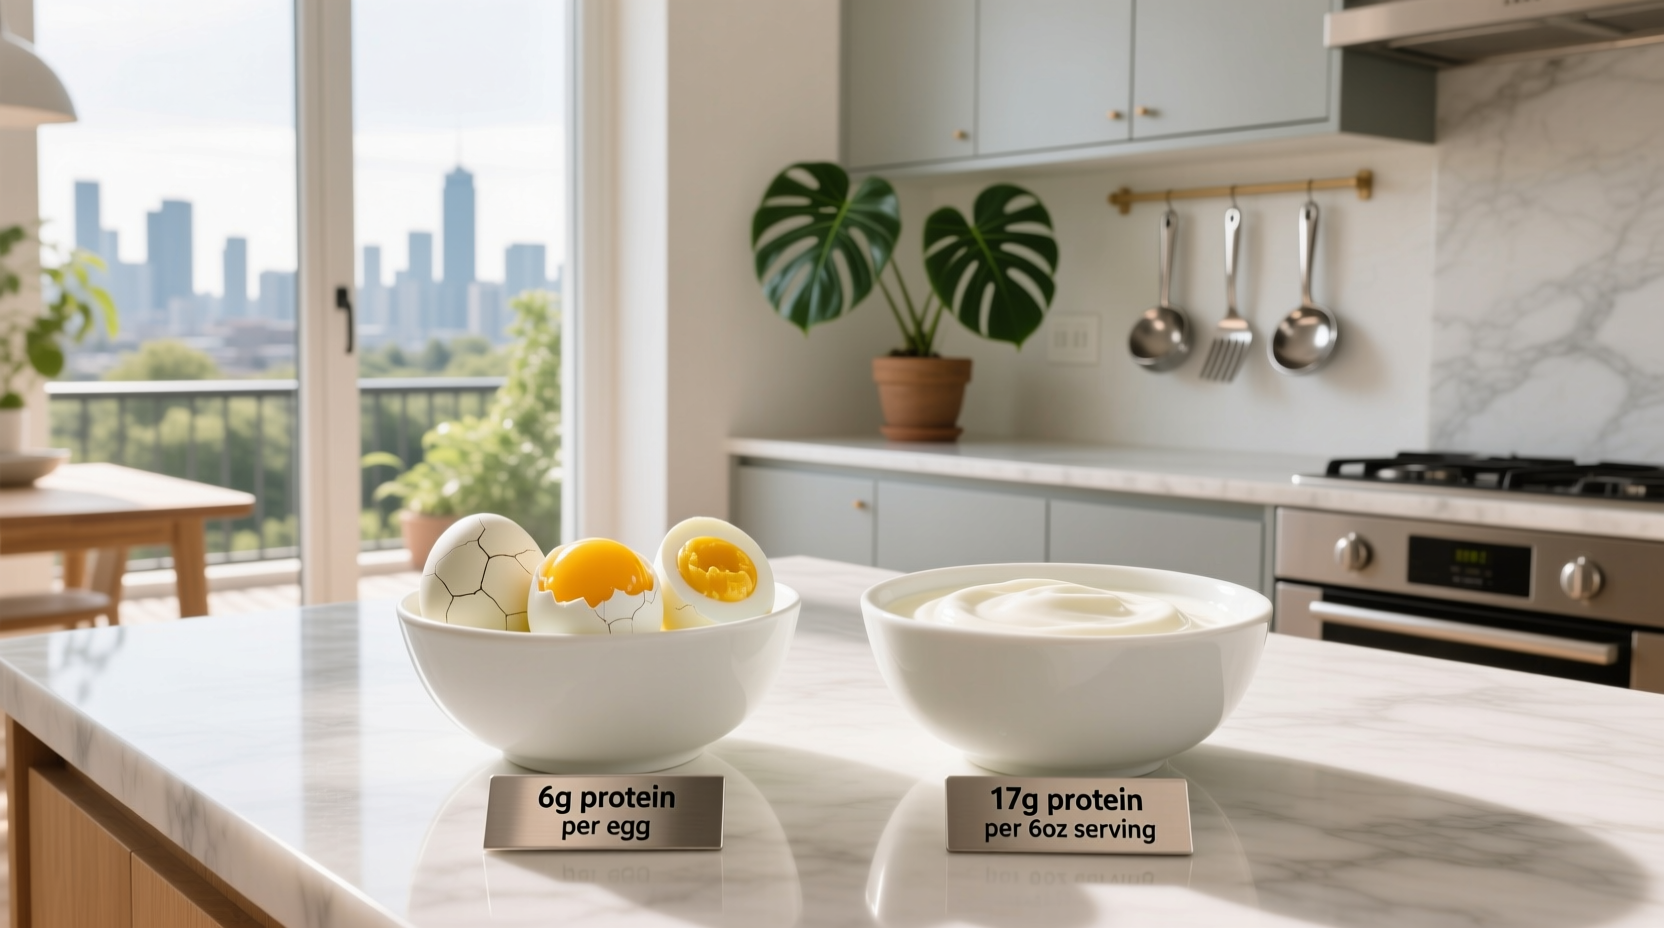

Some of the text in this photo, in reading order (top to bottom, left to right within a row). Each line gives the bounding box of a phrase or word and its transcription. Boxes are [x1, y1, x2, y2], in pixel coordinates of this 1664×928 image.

[538, 784, 676, 815] 6g protein
[990, 786, 1143, 816] 17g protein
[561, 819, 651, 841] per egg
[985, 818, 1156, 845] per 6oz serving
